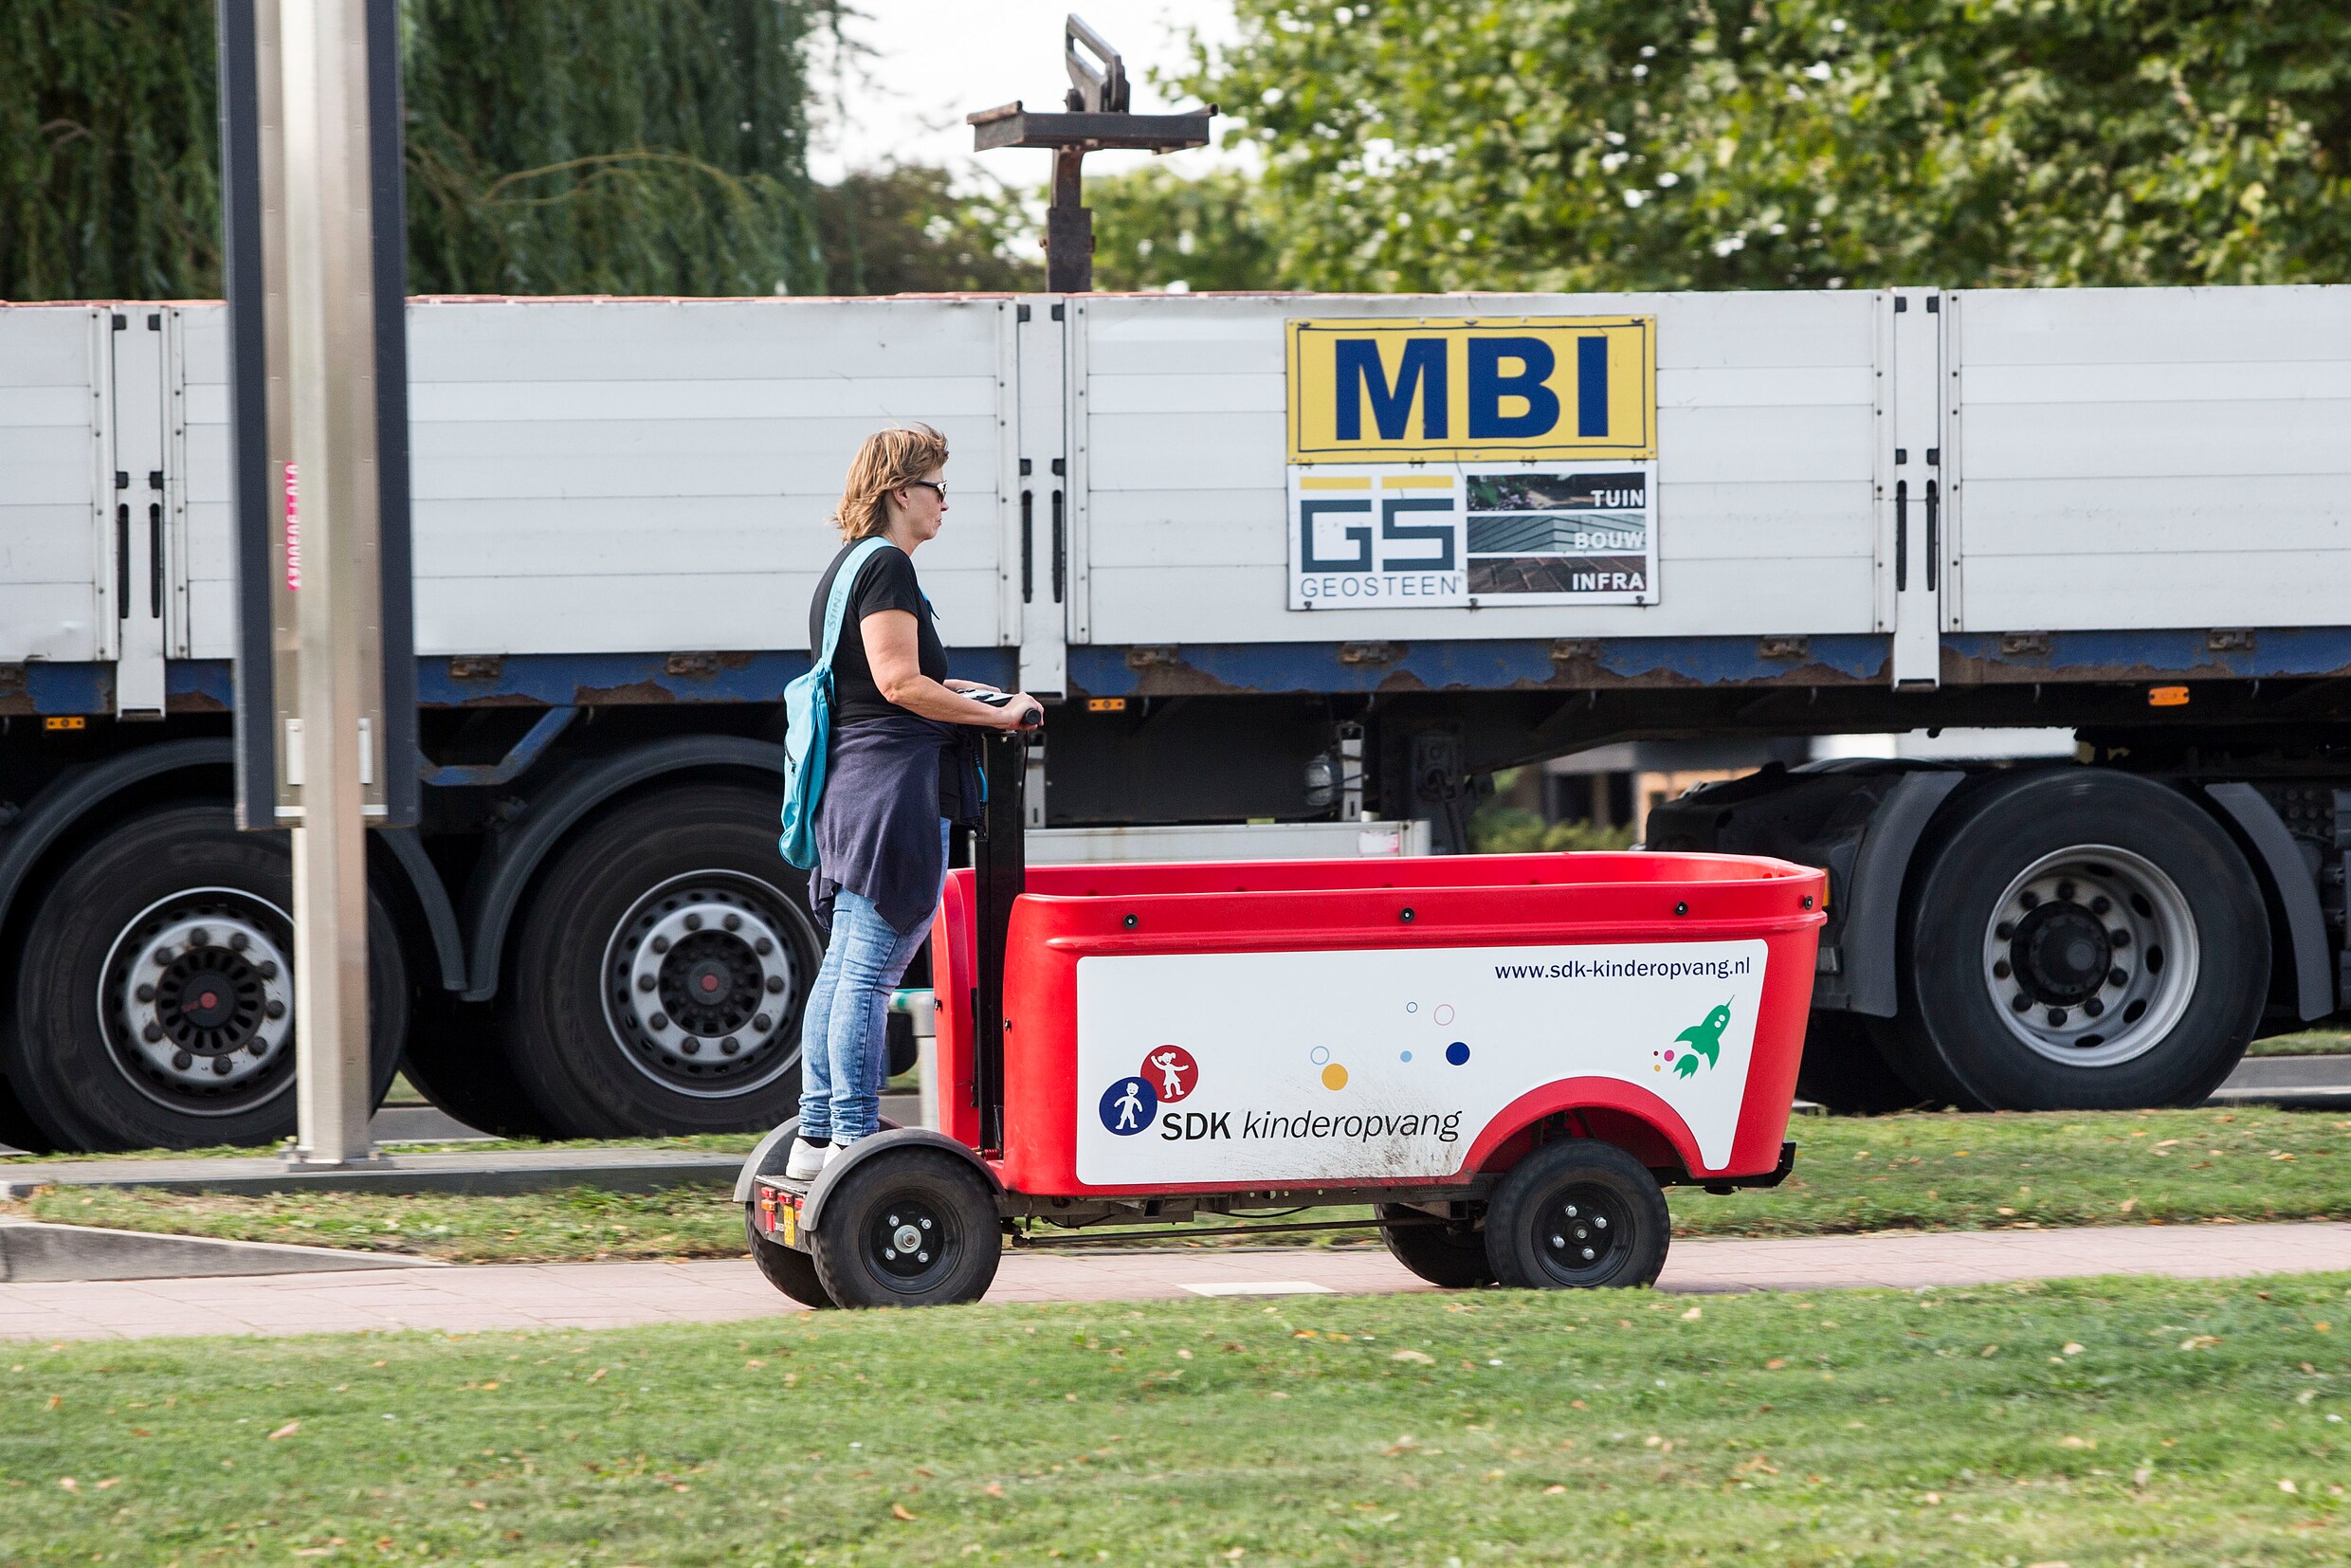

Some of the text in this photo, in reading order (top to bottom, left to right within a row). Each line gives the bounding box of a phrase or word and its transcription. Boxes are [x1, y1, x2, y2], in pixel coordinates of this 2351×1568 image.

[1335, 335, 1609, 441] MBI
[1590, 488, 1645, 507] TUIN
[1300, 497, 1455, 574] GS
[1574, 531, 1644, 550] BOUW
[1300, 575, 1457, 598] GEOSTEEN
[1572, 572, 1645, 591] INFRA
[1494, 957, 1750, 980] www.sdk-kinderopvang.nl
[1160, 1109, 1463, 1143] SDK kinderopvang
